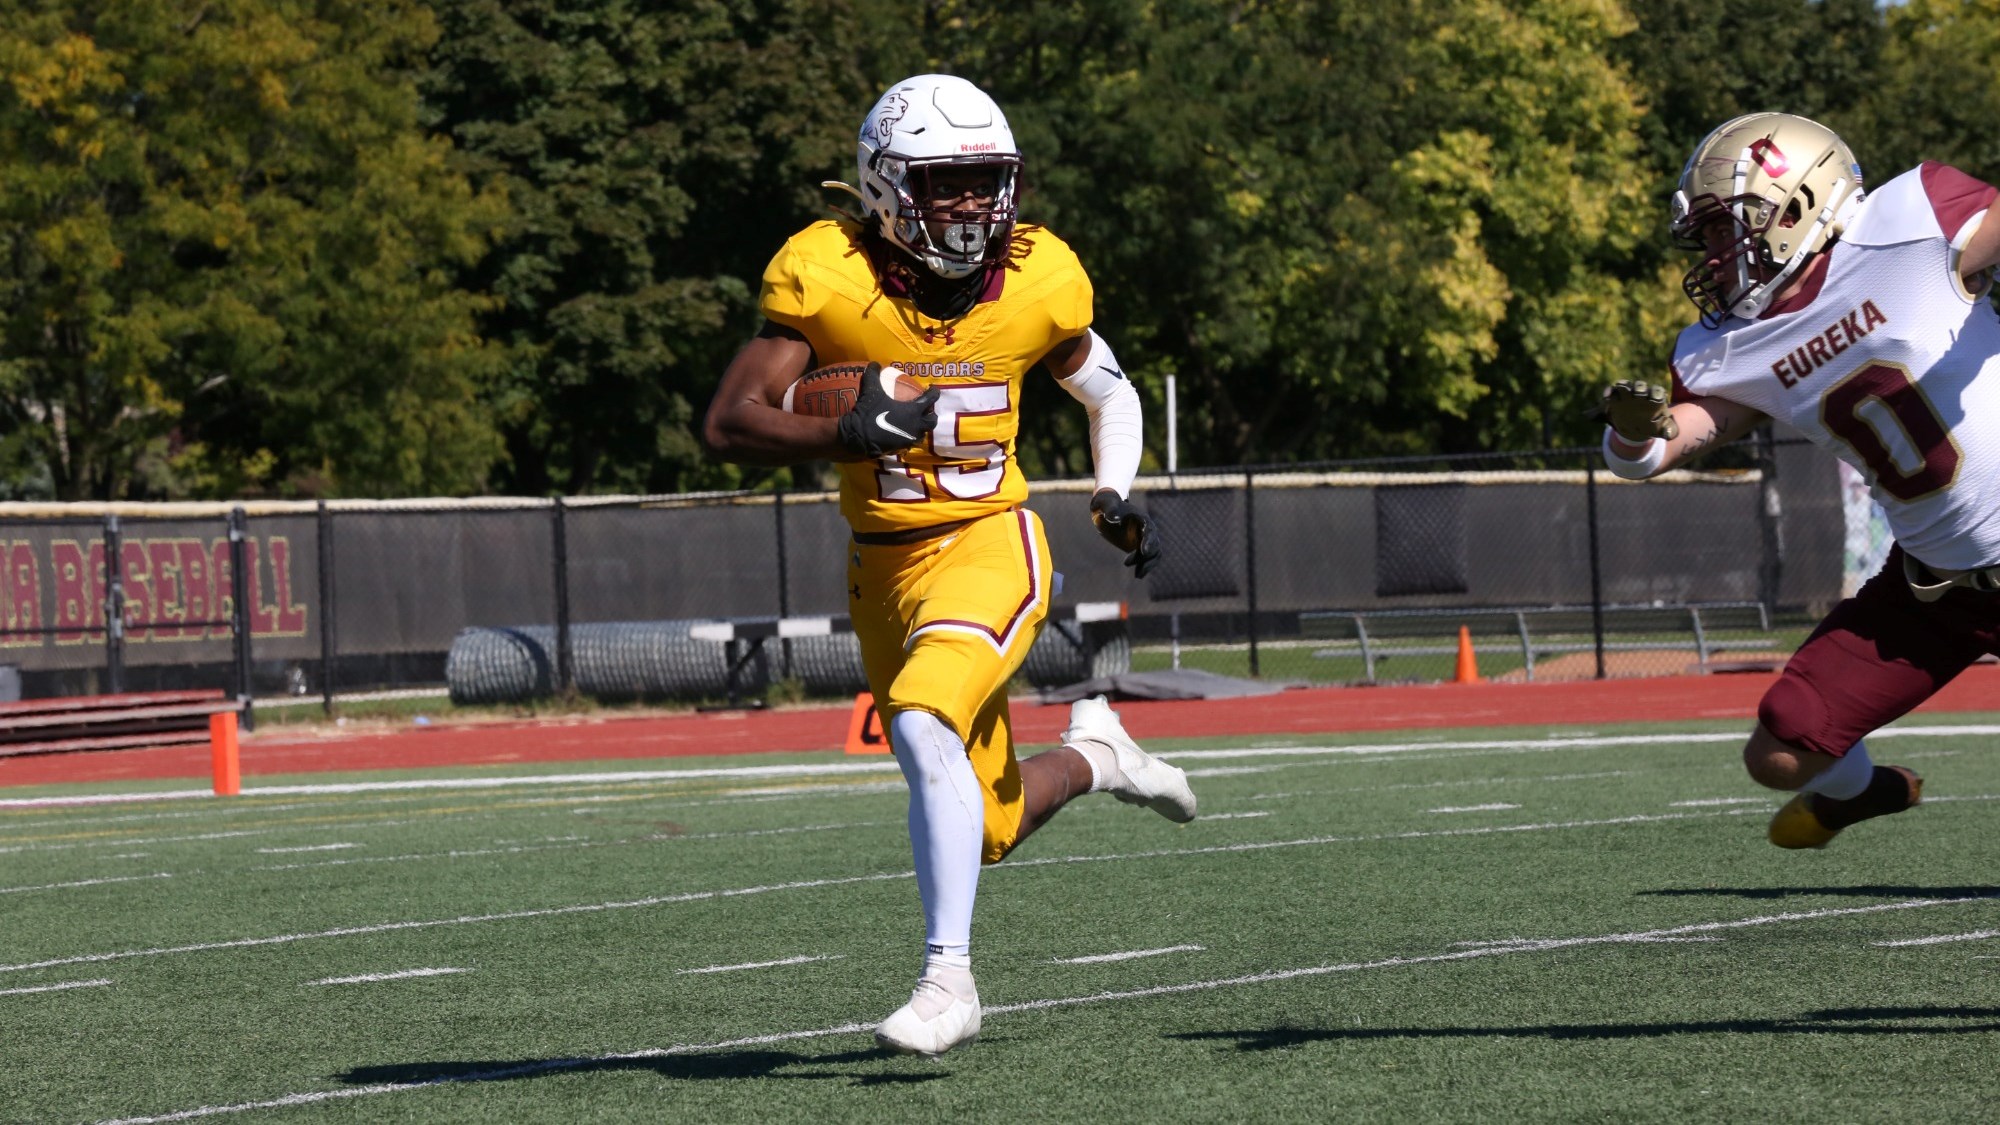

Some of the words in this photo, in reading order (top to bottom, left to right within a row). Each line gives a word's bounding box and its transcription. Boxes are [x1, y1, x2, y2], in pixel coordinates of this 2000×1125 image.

[960, 142, 997, 152] Riddell
[890, 361, 985, 377] COUGARS
[1771, 299, 1889, 390] EUREKA
[51, 536, 307, 646] BASEBALL
